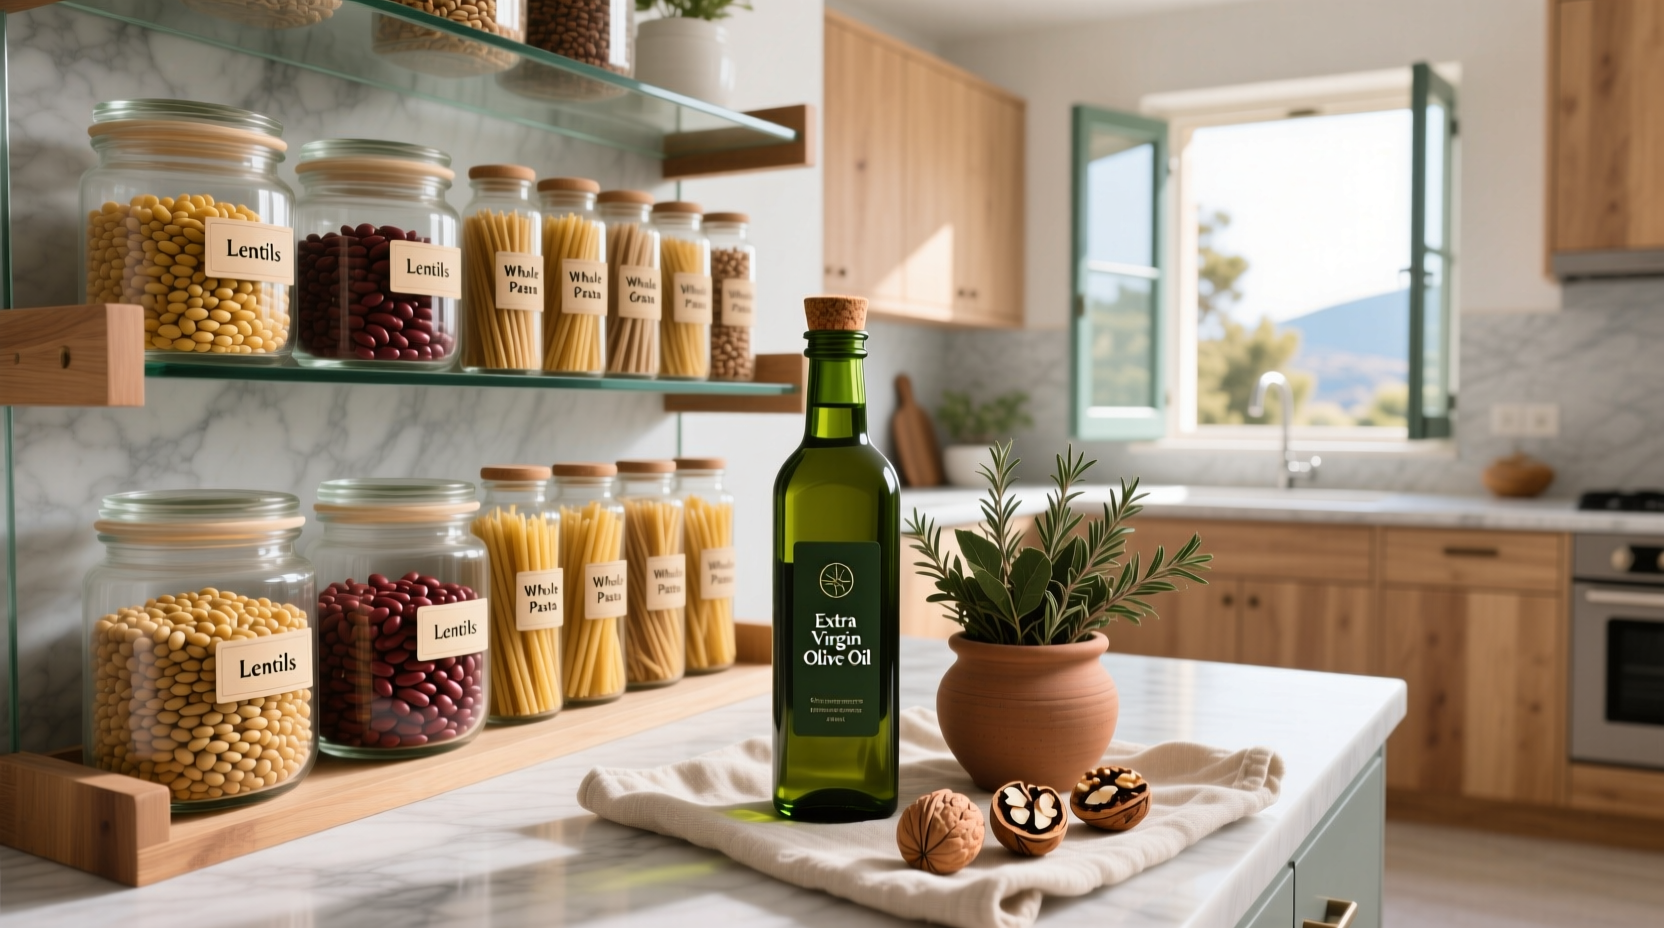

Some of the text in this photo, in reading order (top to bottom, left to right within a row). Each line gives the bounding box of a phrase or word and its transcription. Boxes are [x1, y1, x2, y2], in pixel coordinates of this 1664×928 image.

[226, 239, 281, 262] Lentils
[406, 258, 450, 278] Lentils
[434, 619, 478, 640] Lentils
[815, 613, 857, 628] Extra
[811, 630, 862, 651] Virgin
[239, 652, 297, 679] Lentils
[803, 649, 872, 666] Olive Oil
